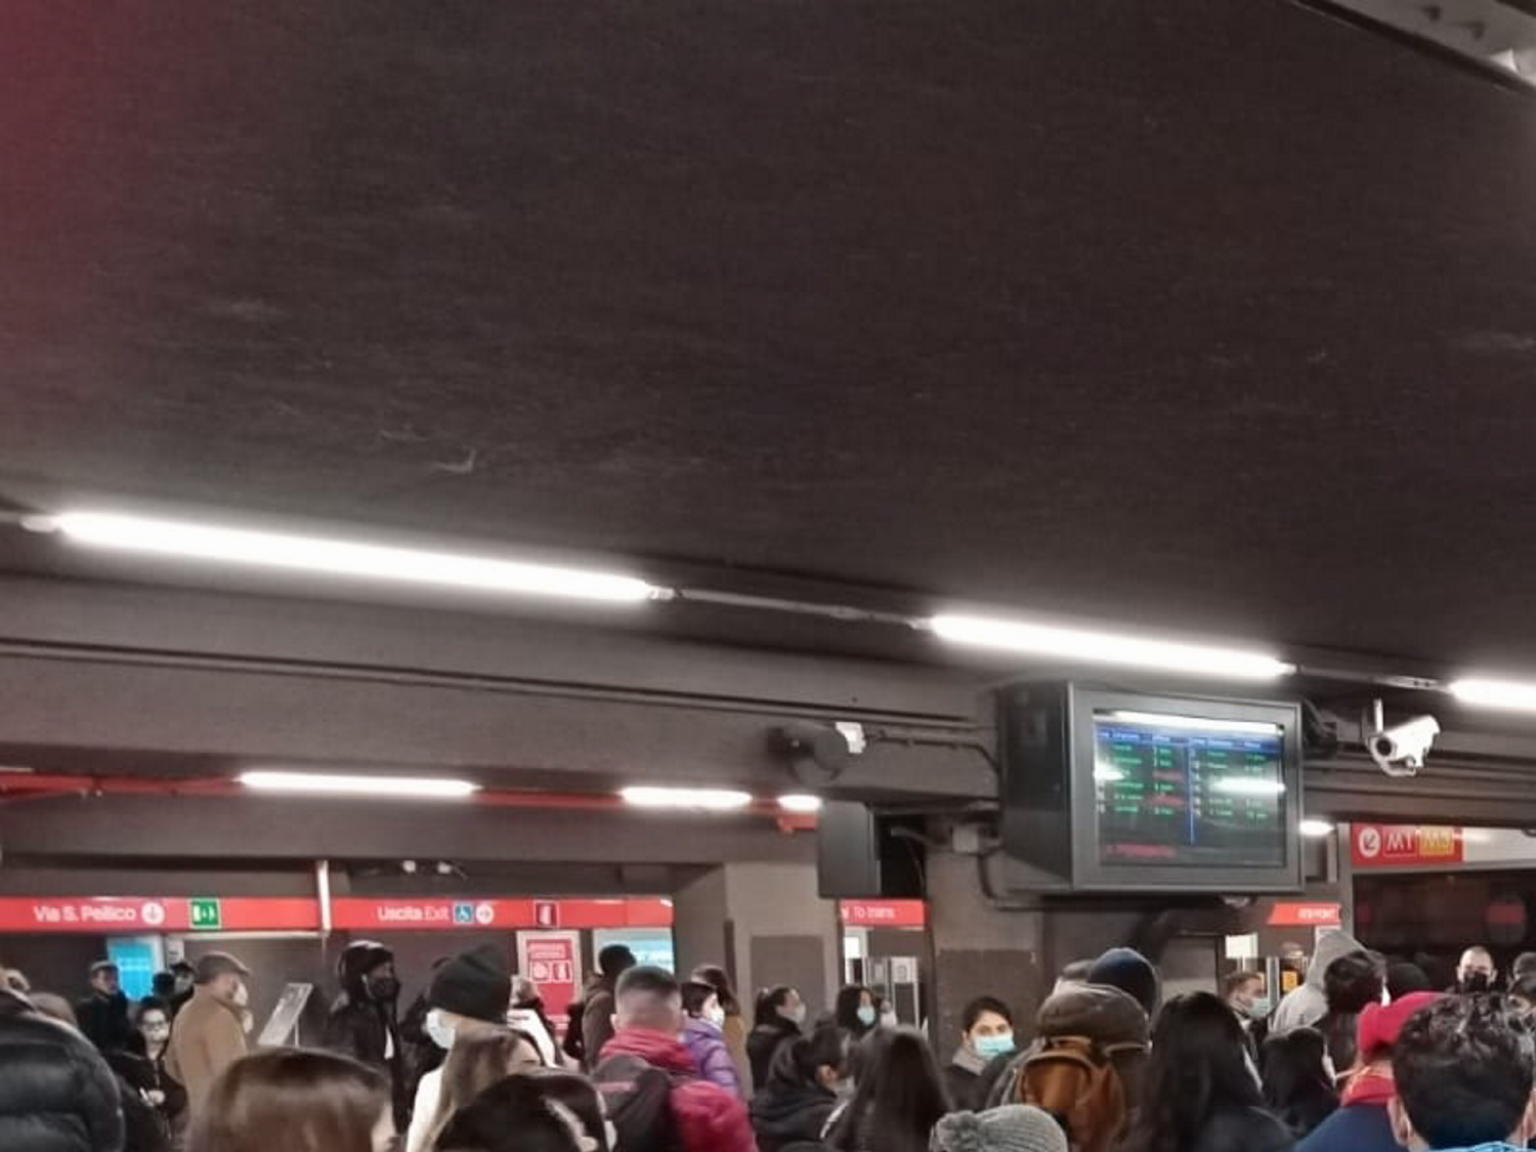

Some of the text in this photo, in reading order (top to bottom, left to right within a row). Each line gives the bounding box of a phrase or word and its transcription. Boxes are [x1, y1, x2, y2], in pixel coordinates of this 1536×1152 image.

[1386, 833, 1413, 850] M1
[32, 905, 60, 922] Via
[81, 905, 137, 922] Pellico
[377, 905, 450, 921] Uscita Exit
